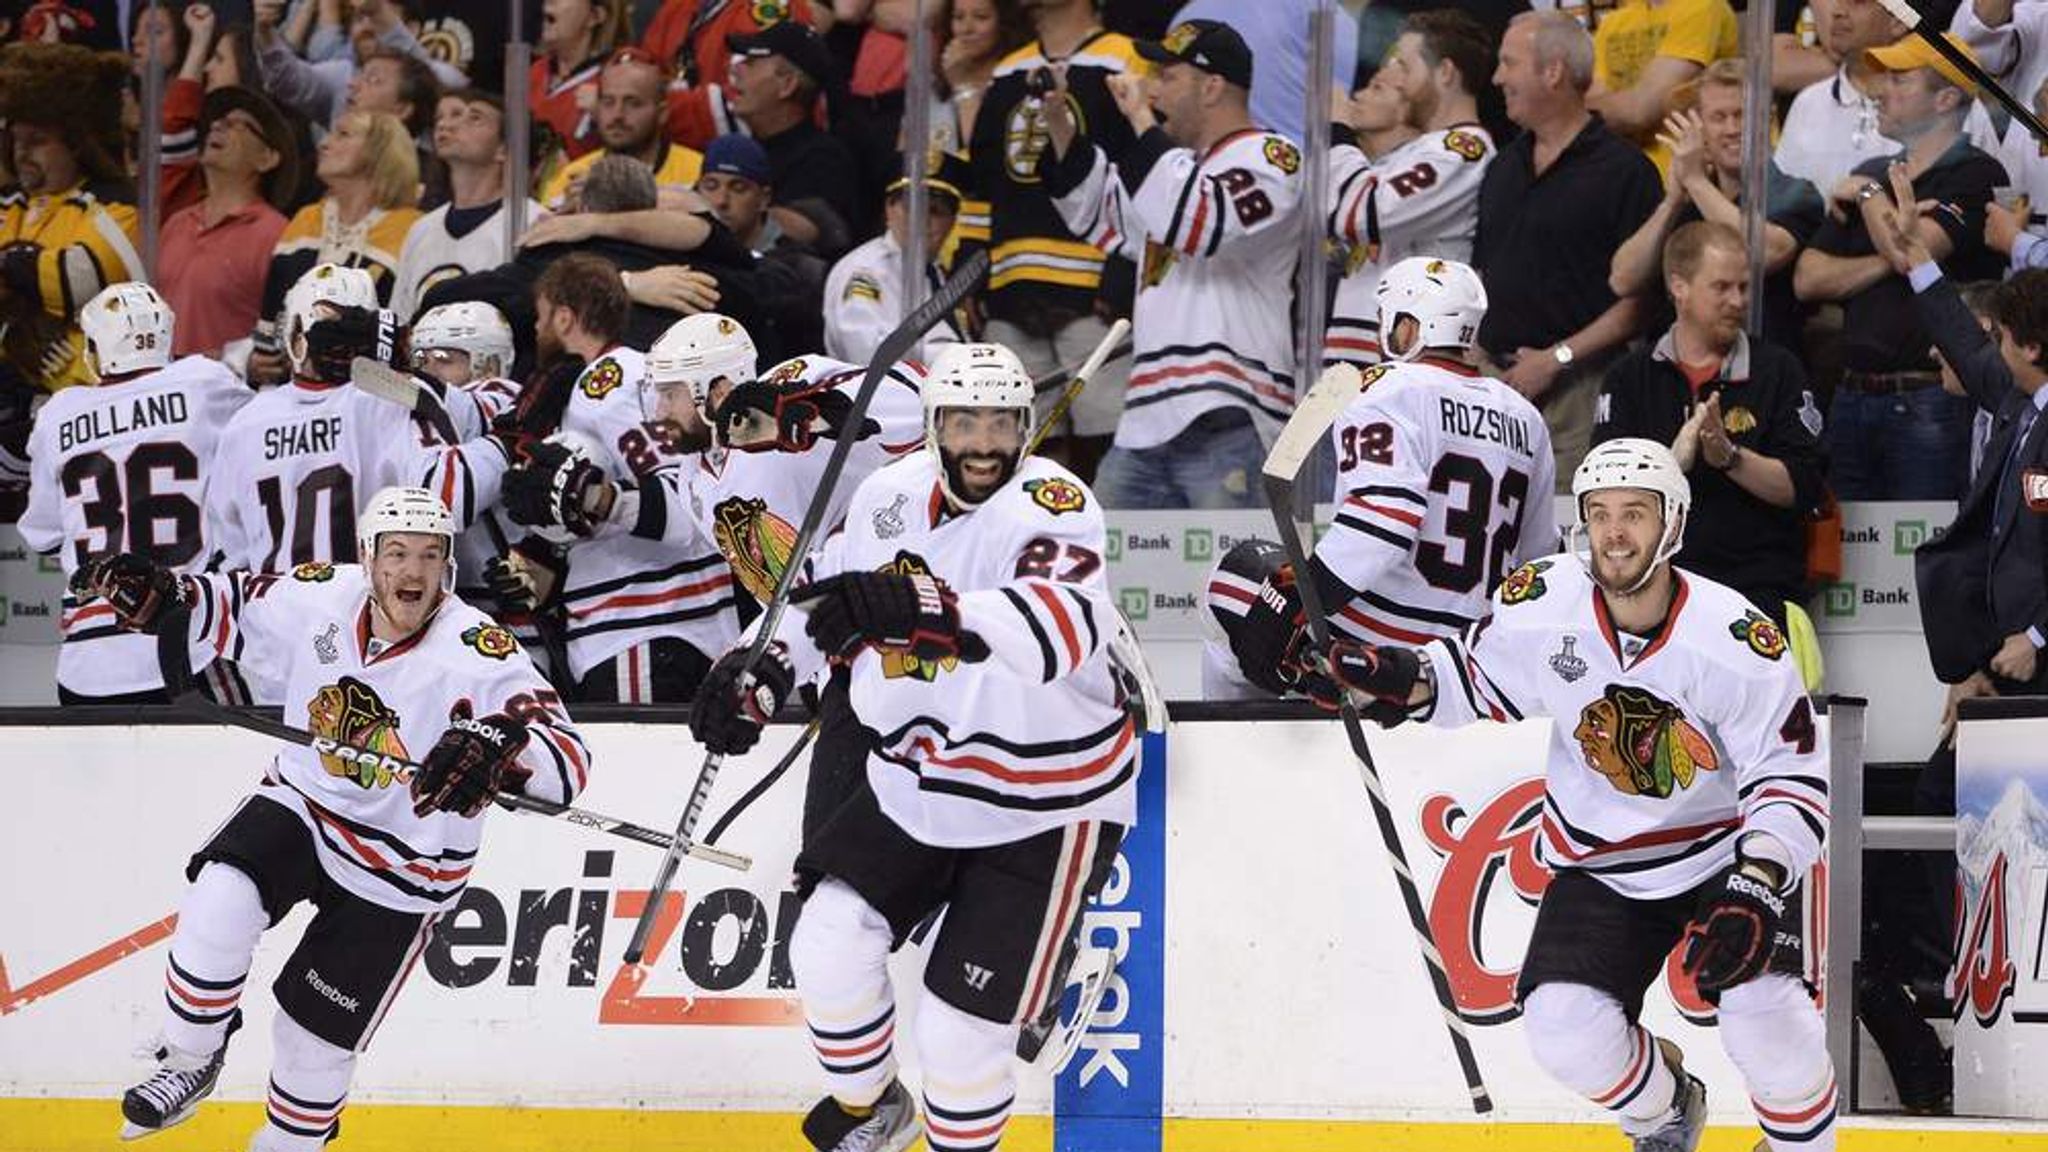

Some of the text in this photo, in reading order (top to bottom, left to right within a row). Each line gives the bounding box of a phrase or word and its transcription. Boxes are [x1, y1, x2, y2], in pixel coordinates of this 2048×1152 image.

[1213, 168, 1275, 228] 88
[134, 333, 156, 350] 36
[59, 391, 189, 451] BOLLAND
[264, 417, 342, 460] SHARP
[1440, 397, 1534, 457] ROZSIVAL
[60, 440, 203, 567] 36
[257, 463, 357, 575] 10
[1415, 452, 1530, 601] 32
[1128, 536, 1171, 550] Bank
[1840, 526, 1880, 542] ank
[1014, 537, 1102, 584] 27
[12, 602, 50, 616] Bank
[1154, 594, 1198, 609] Bank
[1863, 588, 1909, 604] Bank
[311, 737, 422, 778] Reebo
[1727, 873, 1787, 919] Reebok
[424, 851, 799, 1024] erizo
[305, 968, 361, 1013] Reebok
[1079, 850, 1144, 1088] ebok
